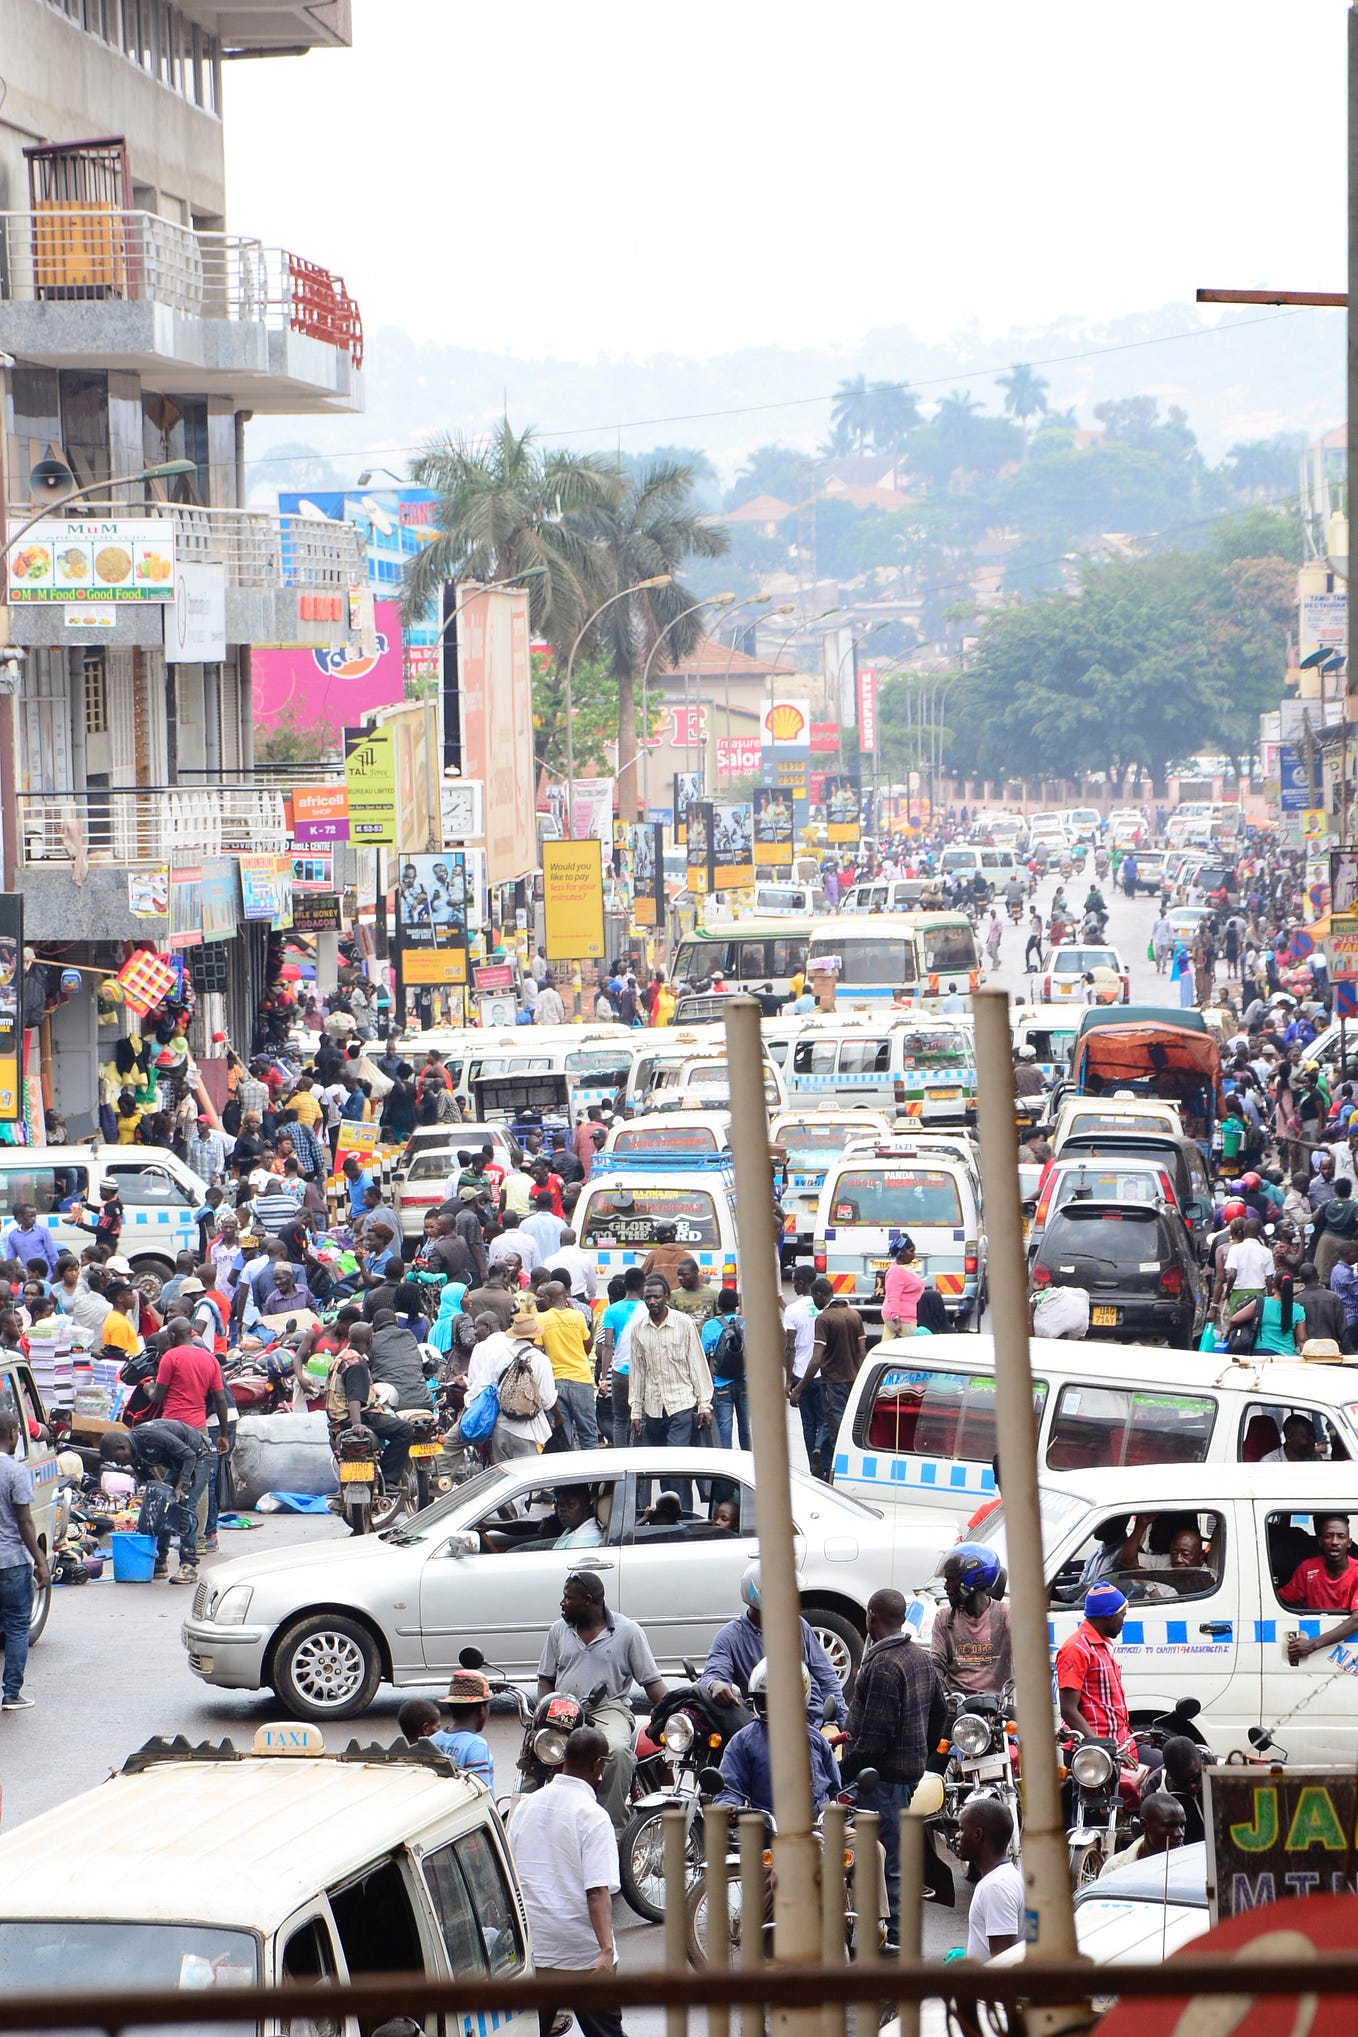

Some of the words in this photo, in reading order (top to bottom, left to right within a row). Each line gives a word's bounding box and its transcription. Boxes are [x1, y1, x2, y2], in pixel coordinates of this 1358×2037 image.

[51, 589, 76, 600] Food
[87, 589, 114, 600] Good
[862, 672, 874, 749] SHOPRITE
[299, 795, 344, 807] africell
[325, 825, 337, 834] 72
[551, 863, 576, 871] Would
[575, 874, 590, 882] pay
[885, 1171, 915, 1179] PANDA
[592, 1232, 613, 1242] TO
[617, 1231, 650, 1241] THE
[263, 1730, 308, 1746] TAXI
